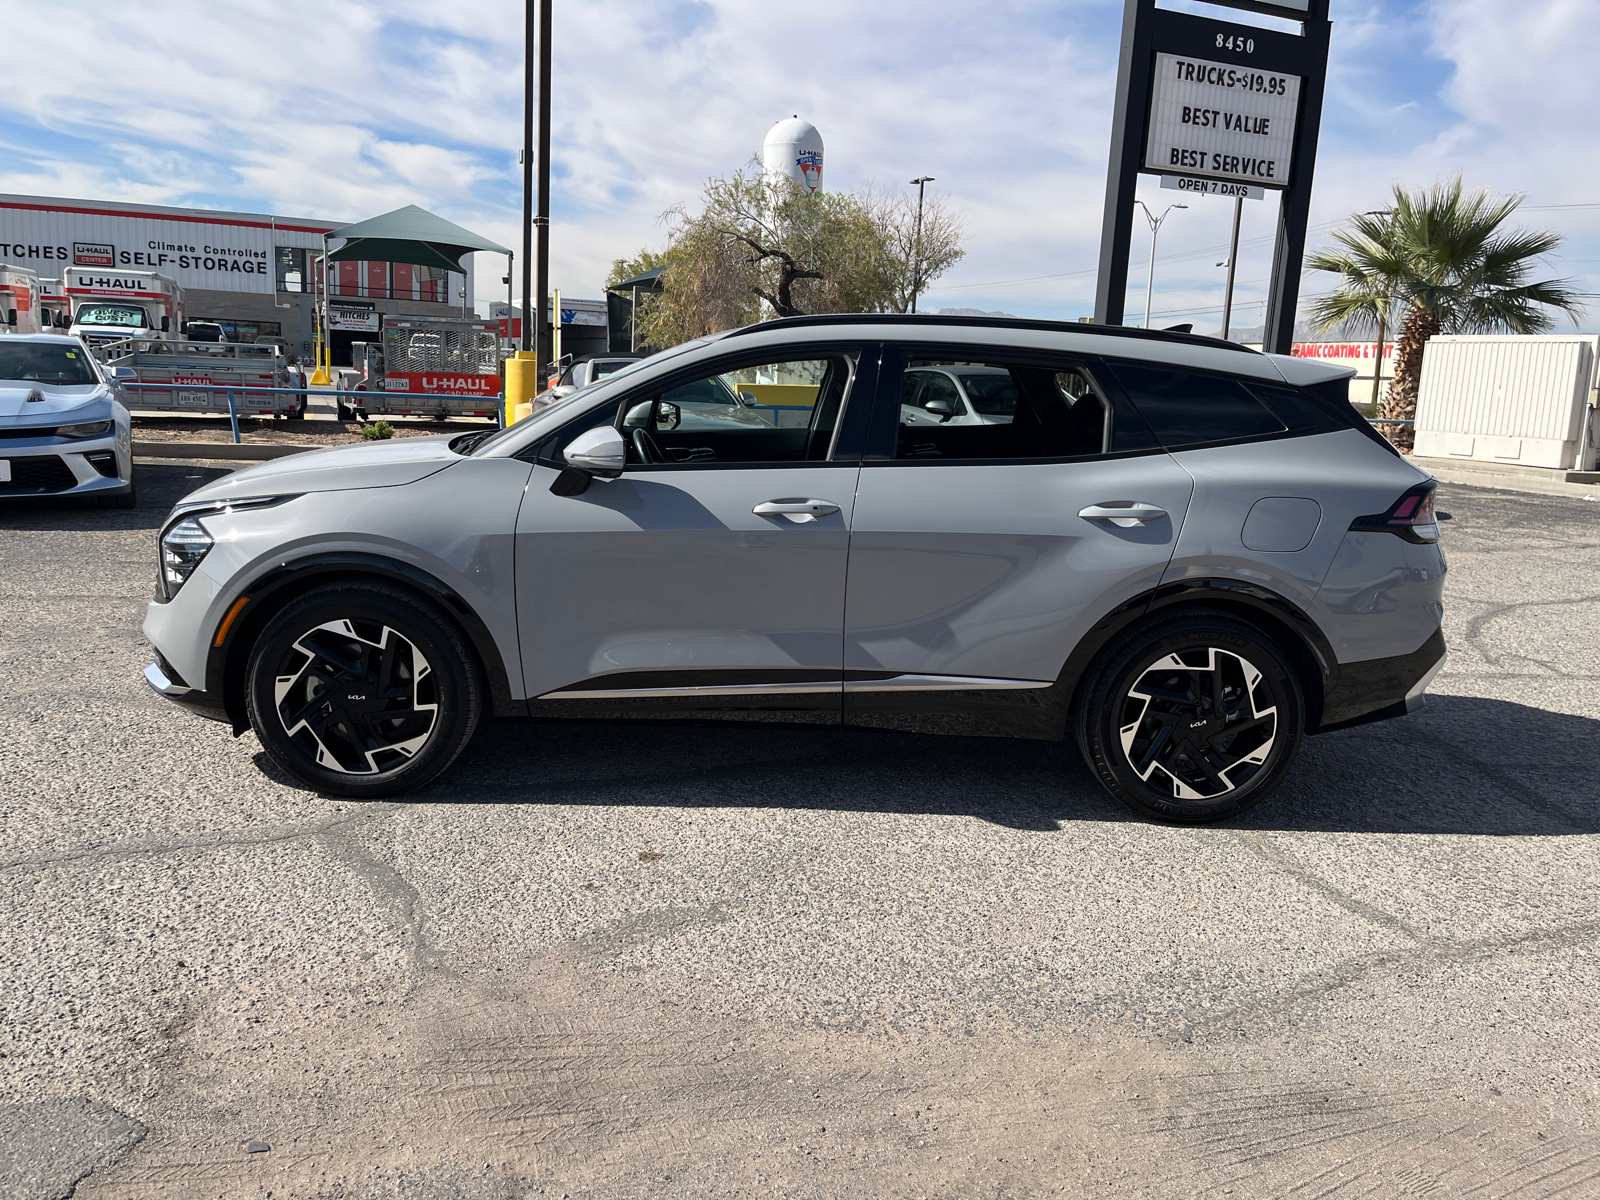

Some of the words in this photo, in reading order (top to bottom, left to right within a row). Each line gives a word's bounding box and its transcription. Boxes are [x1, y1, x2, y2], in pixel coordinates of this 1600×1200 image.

[1215, 33, 1255, 54] 8450
[1176, 61, 1286, 95] TRUCKS-$19.95
[1182, 106, 1220, 128] BEST
[1224, 112, 1270, 136] VALUE
[1170, 148, 1207, 169] BEST
[1212, 153, 1275, 178] SERVICE
[1178, 178, 1208, 192] OPEN
[1212, 183, 1218, 193] 7
[1220, 184, 1248, 197] DAYS
[77, 246, 110, 255] U-HAUL
[148, 240, 196, 253] Climate
[203, 245, 267, 259] Controlled
[119, 250, 267, 275] SELF-STORAGE
[79, 276, 147, 290] U-HAUL
[88, 308, 135, 318] LOWEST
[340, 311, 371, 320] HITCHES
[1322, 344, 1361, 358] COATING
[1363, 344, 1369, 358] &
[422, 377, 490, 390] U-HAUL
[1189, 719, 1207, 729] KIA
